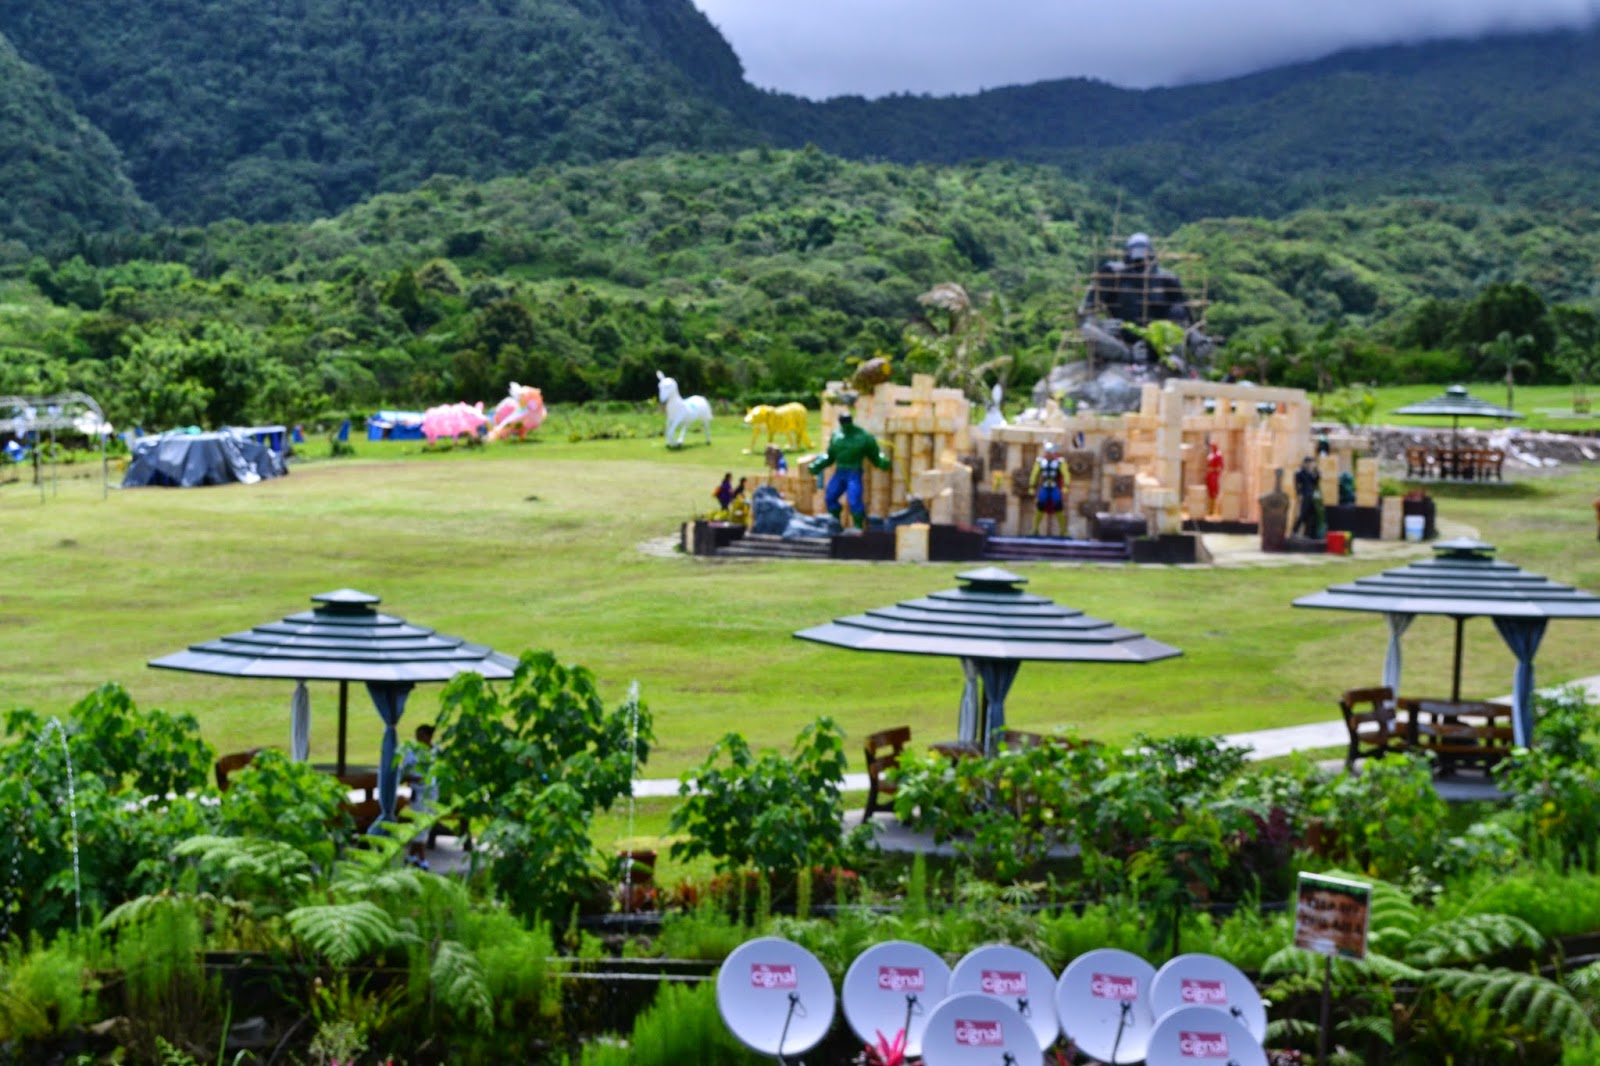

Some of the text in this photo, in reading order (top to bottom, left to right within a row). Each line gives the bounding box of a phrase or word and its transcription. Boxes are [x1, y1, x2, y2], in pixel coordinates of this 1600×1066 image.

[752, 965, 796, 988] cignal
[879, 968, 924, 991] cignal
[982, 971, 1026, 994] cignal
[1092, 975, 1136, 999] cignal
[956, 1021, 1001, 1045] cignal
[1181, 1034, 1226, 1057] cignal
